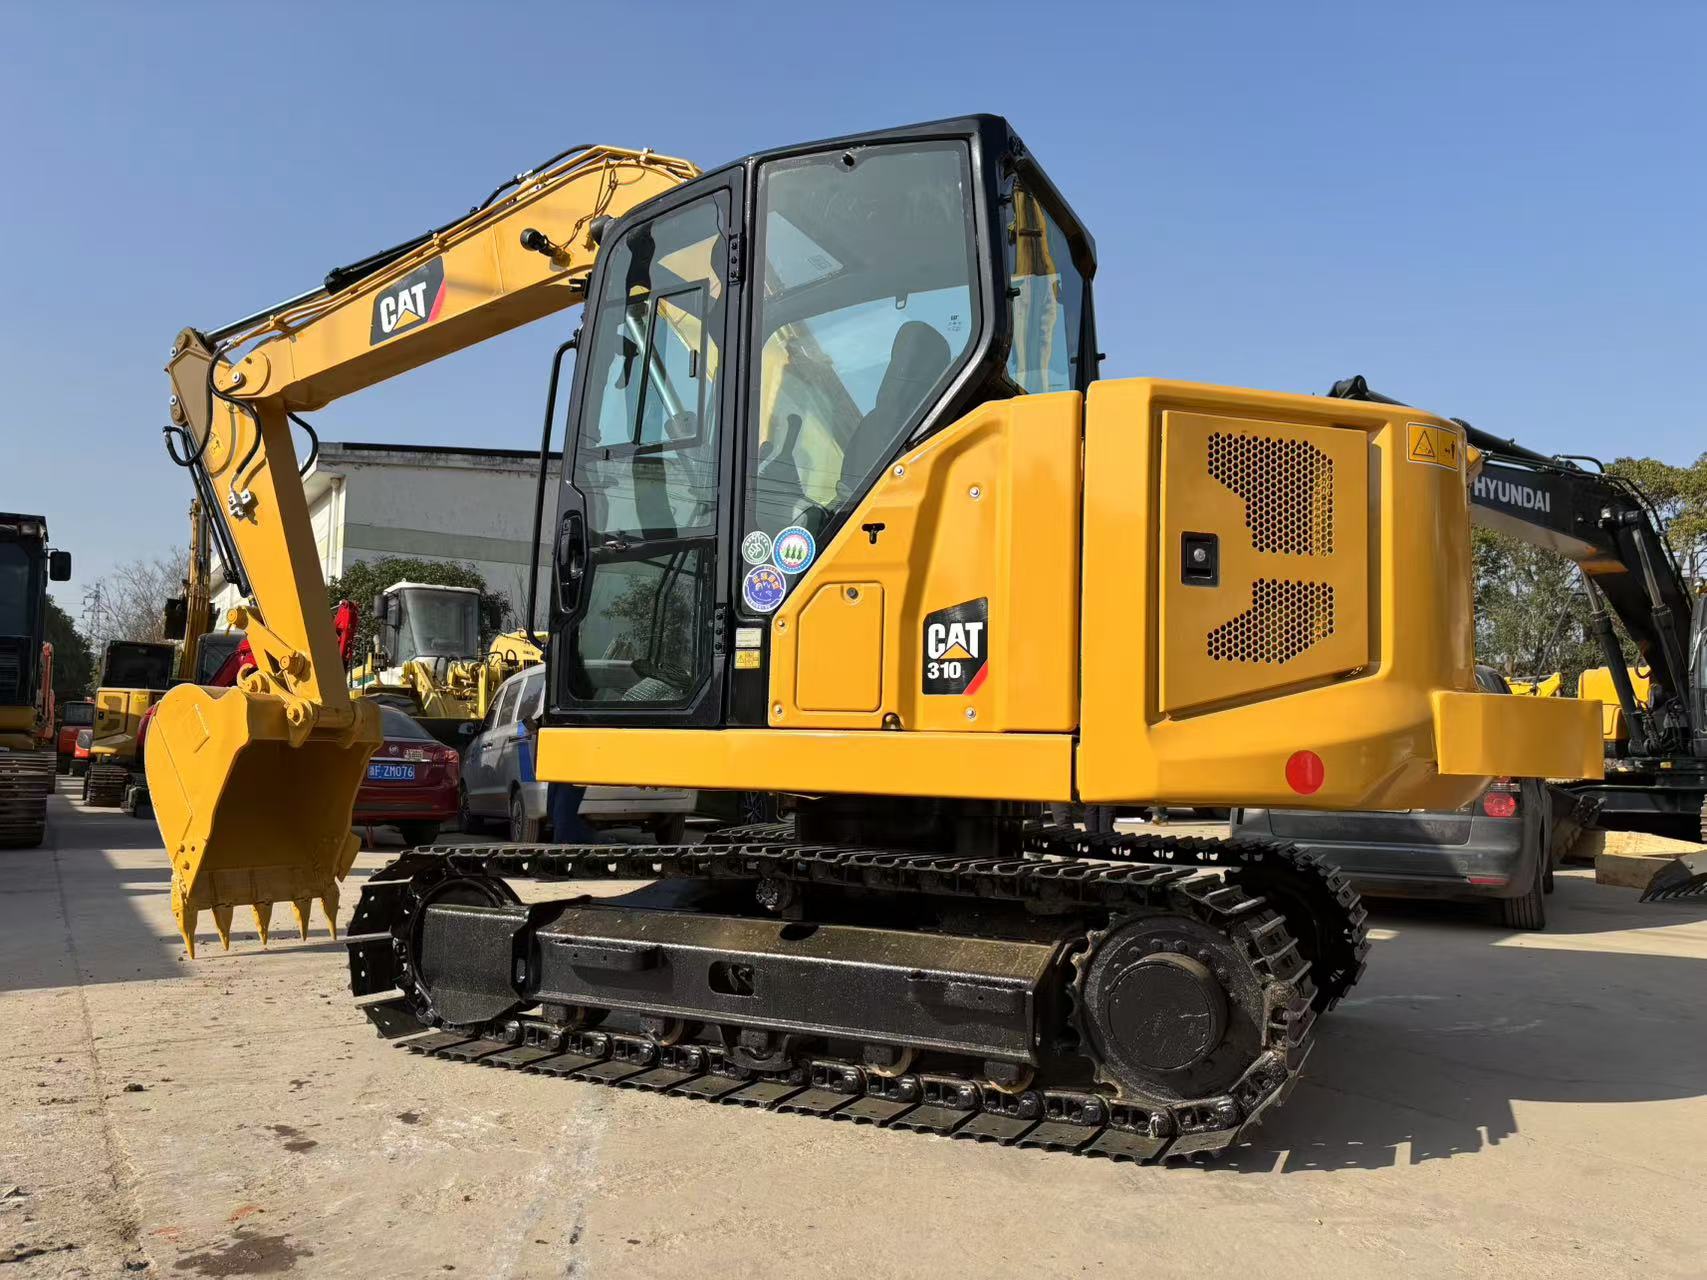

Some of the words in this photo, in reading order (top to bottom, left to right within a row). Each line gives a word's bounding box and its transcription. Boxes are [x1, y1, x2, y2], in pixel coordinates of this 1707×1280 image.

[380, 281, 427, 333] CAT
[1474, 476, 1551, 513] HYUNDAI
[928, 622, 984, 660] CAT
[927, 661, 962, 679] 310
